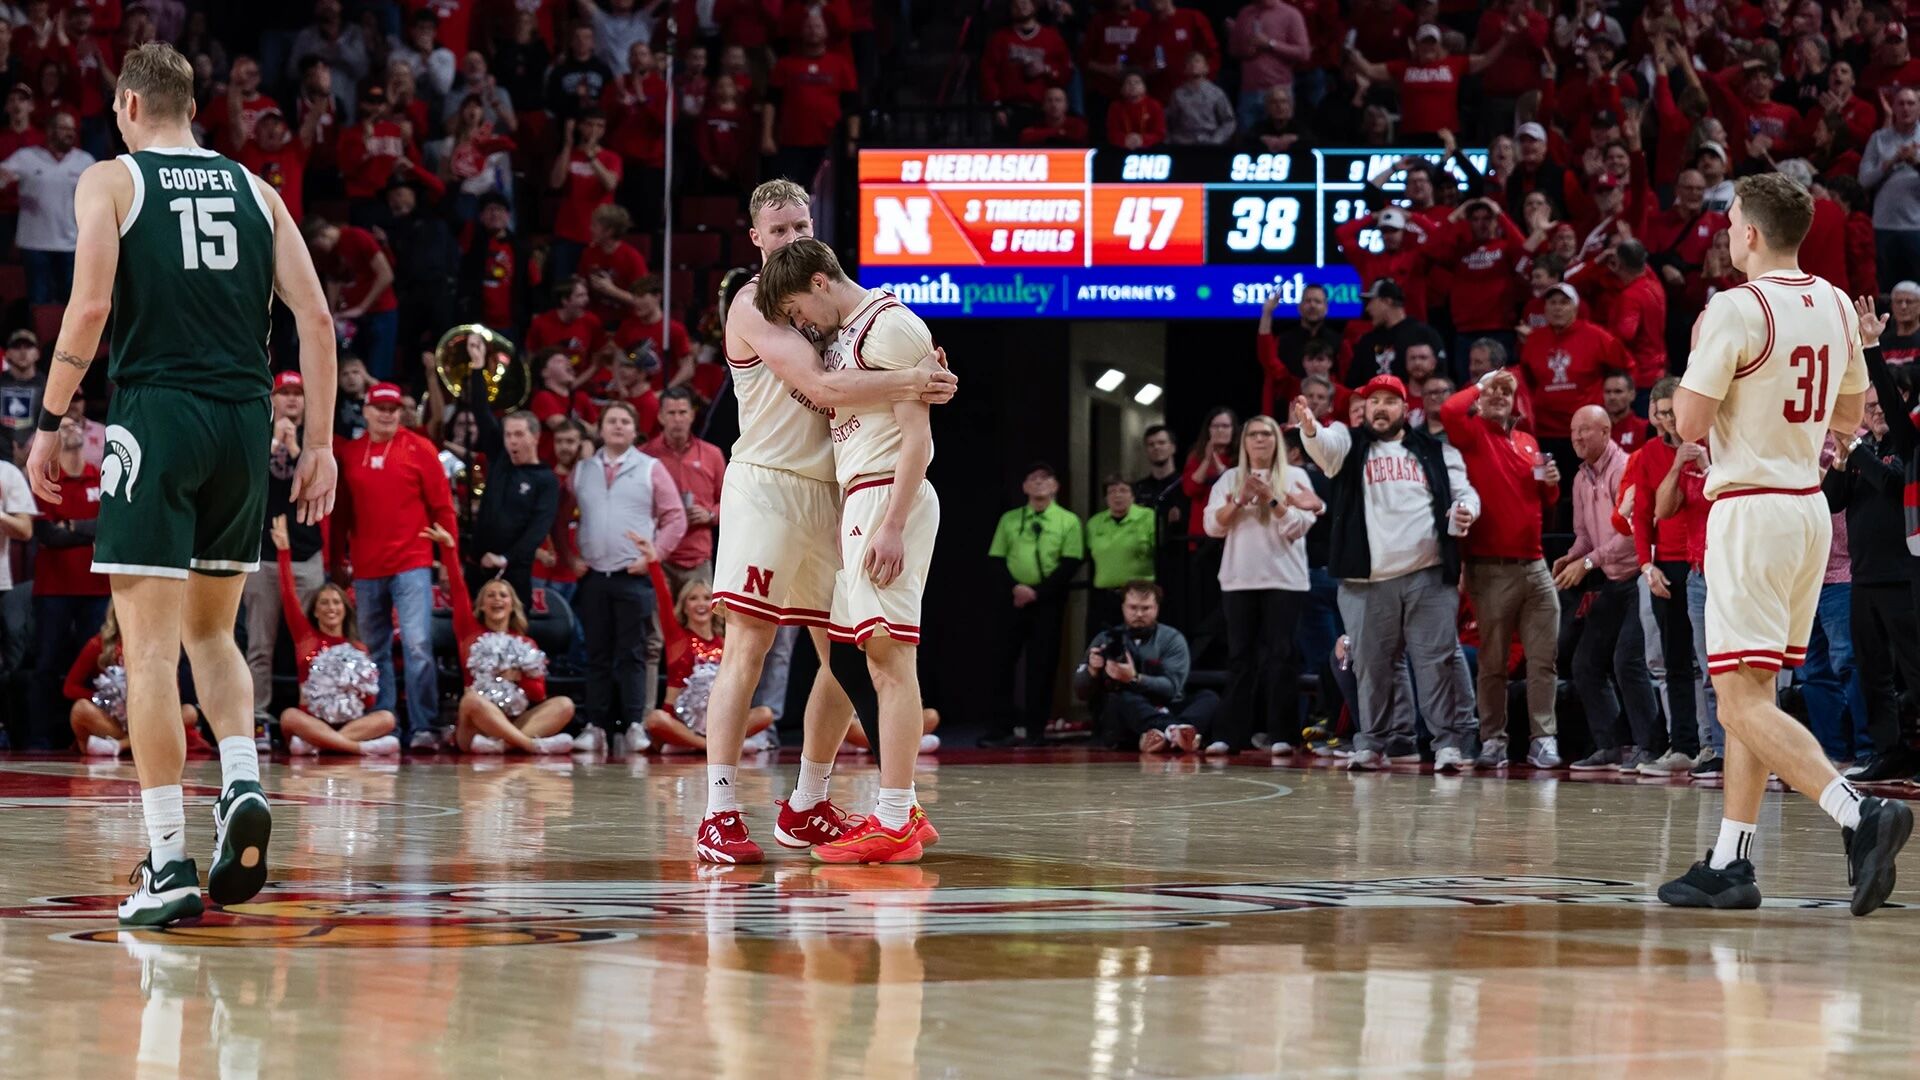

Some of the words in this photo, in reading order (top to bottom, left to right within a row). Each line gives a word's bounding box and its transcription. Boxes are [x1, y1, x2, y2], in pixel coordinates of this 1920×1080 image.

[158, 167, 238, 192] COOPER
[924, 154, 1048, 182] NEBRASKA
[1122, 154, 1172, 180] 2ND
[1230, 153, 1291, 182] 9:29
[963, 199, 982, 222] 3
[984, 199, 1082, 222] TIMEOUTS
[1112, 196, 1184, 251] 47
[1226, 196, 1300, 251] 38
[169, 197, 239, 270] 15
[873, 196, 932, 255] N
[990, 229, 1009, 252] 5
[1010, 229, 1076, 252] FOULS
[961, 273, 1054, 314] pauley
[1077, 285, 1176, 301] ATTORNEYS
[1801, 295, 1815, 307] N
[1783, 344, 1829, 423] 31
[743, 565, 775, 599] N
